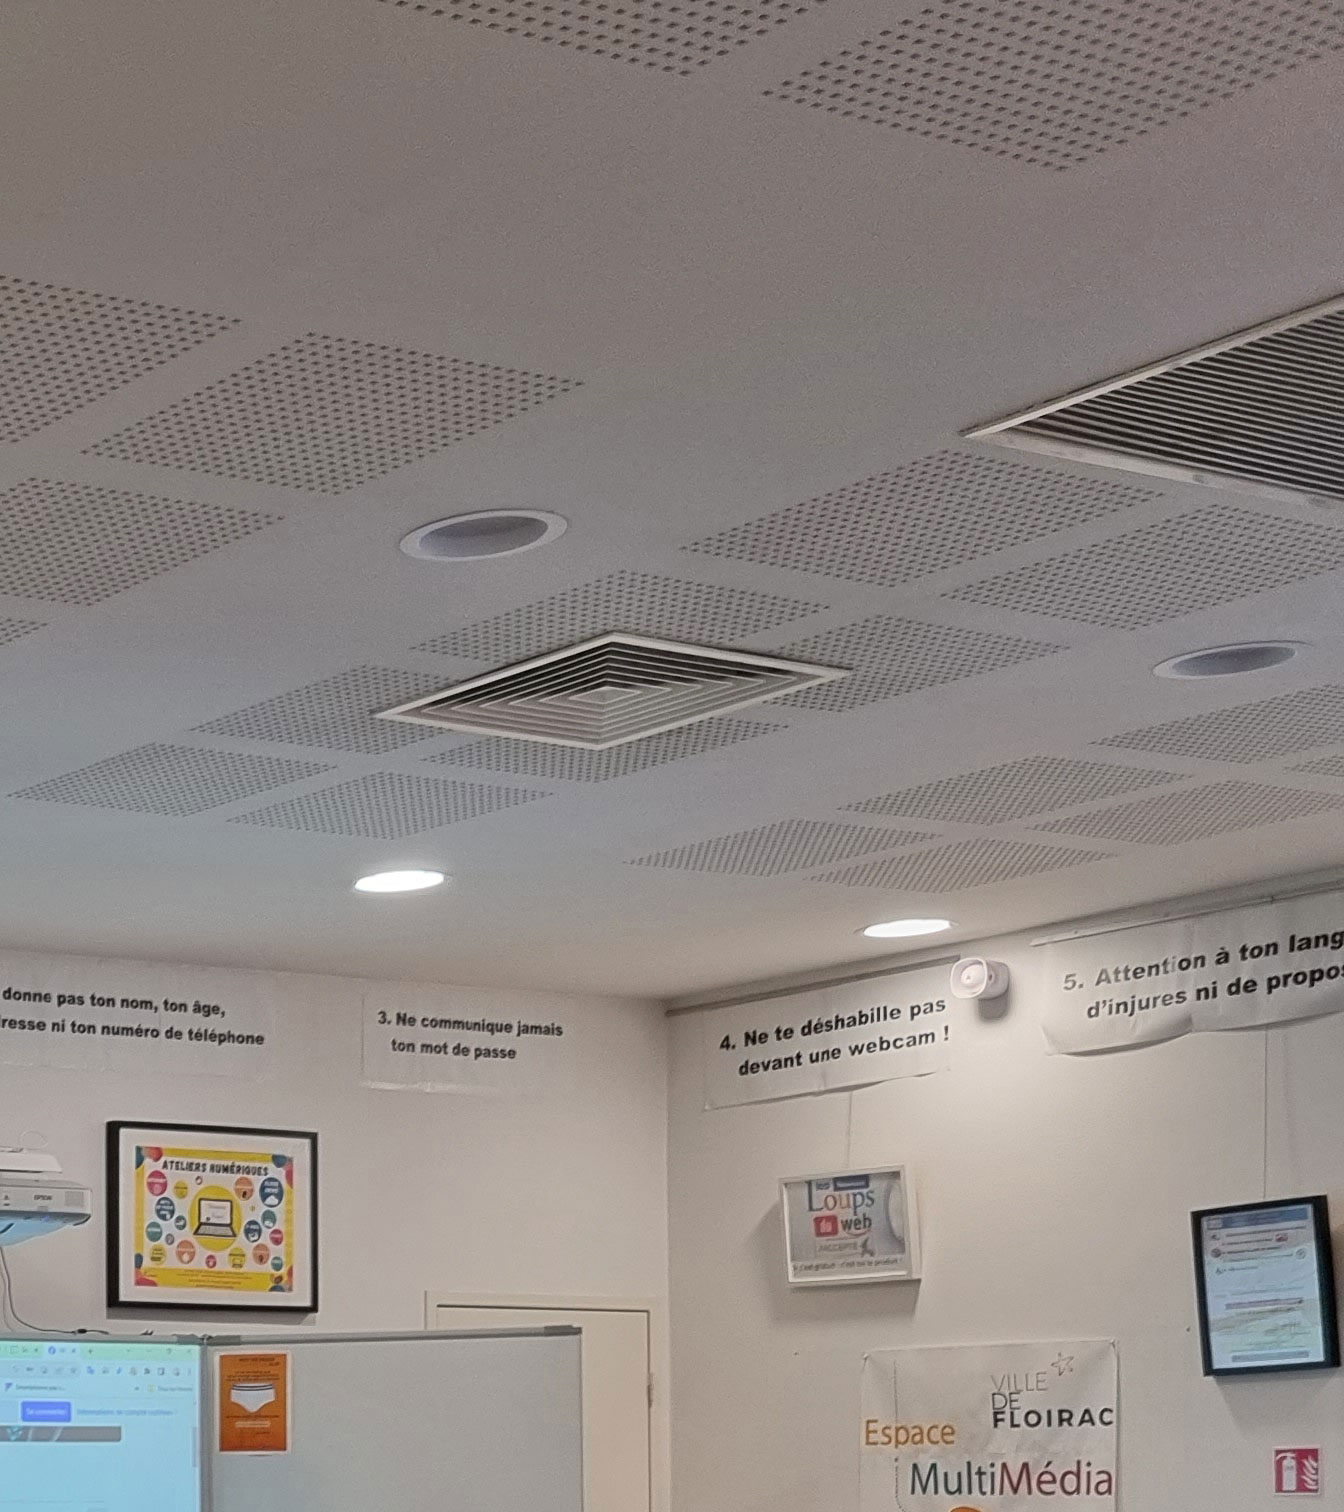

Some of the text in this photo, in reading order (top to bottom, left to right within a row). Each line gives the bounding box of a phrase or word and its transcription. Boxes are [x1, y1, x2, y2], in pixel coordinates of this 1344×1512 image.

[1063, 973, 1084, 990] 5.
[1095, 952, 1206, 987] Attention
[1215, 946, 1229, 965] à
[1239, 942, 1278, 961] ton
[3, 987, 51, 1003] donne
[57, 994, 84, 1007] pas
[90, 994, 115, 1008] ton
[120, 999, 158, 1012] nom,
[164, 999, 187, 1013] ton
[192, 1001, 225, 1018] âge,
[1087, 989, 1187, 1018] d'injures
[1196, 982, 1217, 1000] ni
[1226, 977, 1257, 996] de
[51, 1019, 65, 1033] ni
[71, 1020, 96, 1035] ton
[101, 1021, 160, 1039] numéro
[164, 1026, 182, 1040] de
[188, 1028, 264, 1046] téléphone
[378, 1011, 563, 1037] 3. Ne communique jamais
[720, 1000, 946, 1050] 4. Ne te déshabille pas
[391, 1038, 516, 1060] ton mot de passe
[739, 1052, 802, 1075] devant
[809, 1046, 841, 1064] une
[849, 1032, 935, 1056] webcam
[162, 1160, 268, 1176] ATELIERS NUMÉRIQUES
[805, 1181, 875, 1216] Loups
[841, 1213, 872, 1230] web
[990, 1371, 1047, 1393] VILLE
[991, 1392, 1021, 1411] DE
[992, 1408, 1114, 1429] FLOIRAC
[864, 1419, 956, 1449] Espace
[910, 1460, 1113, 1497] MultiMédia
